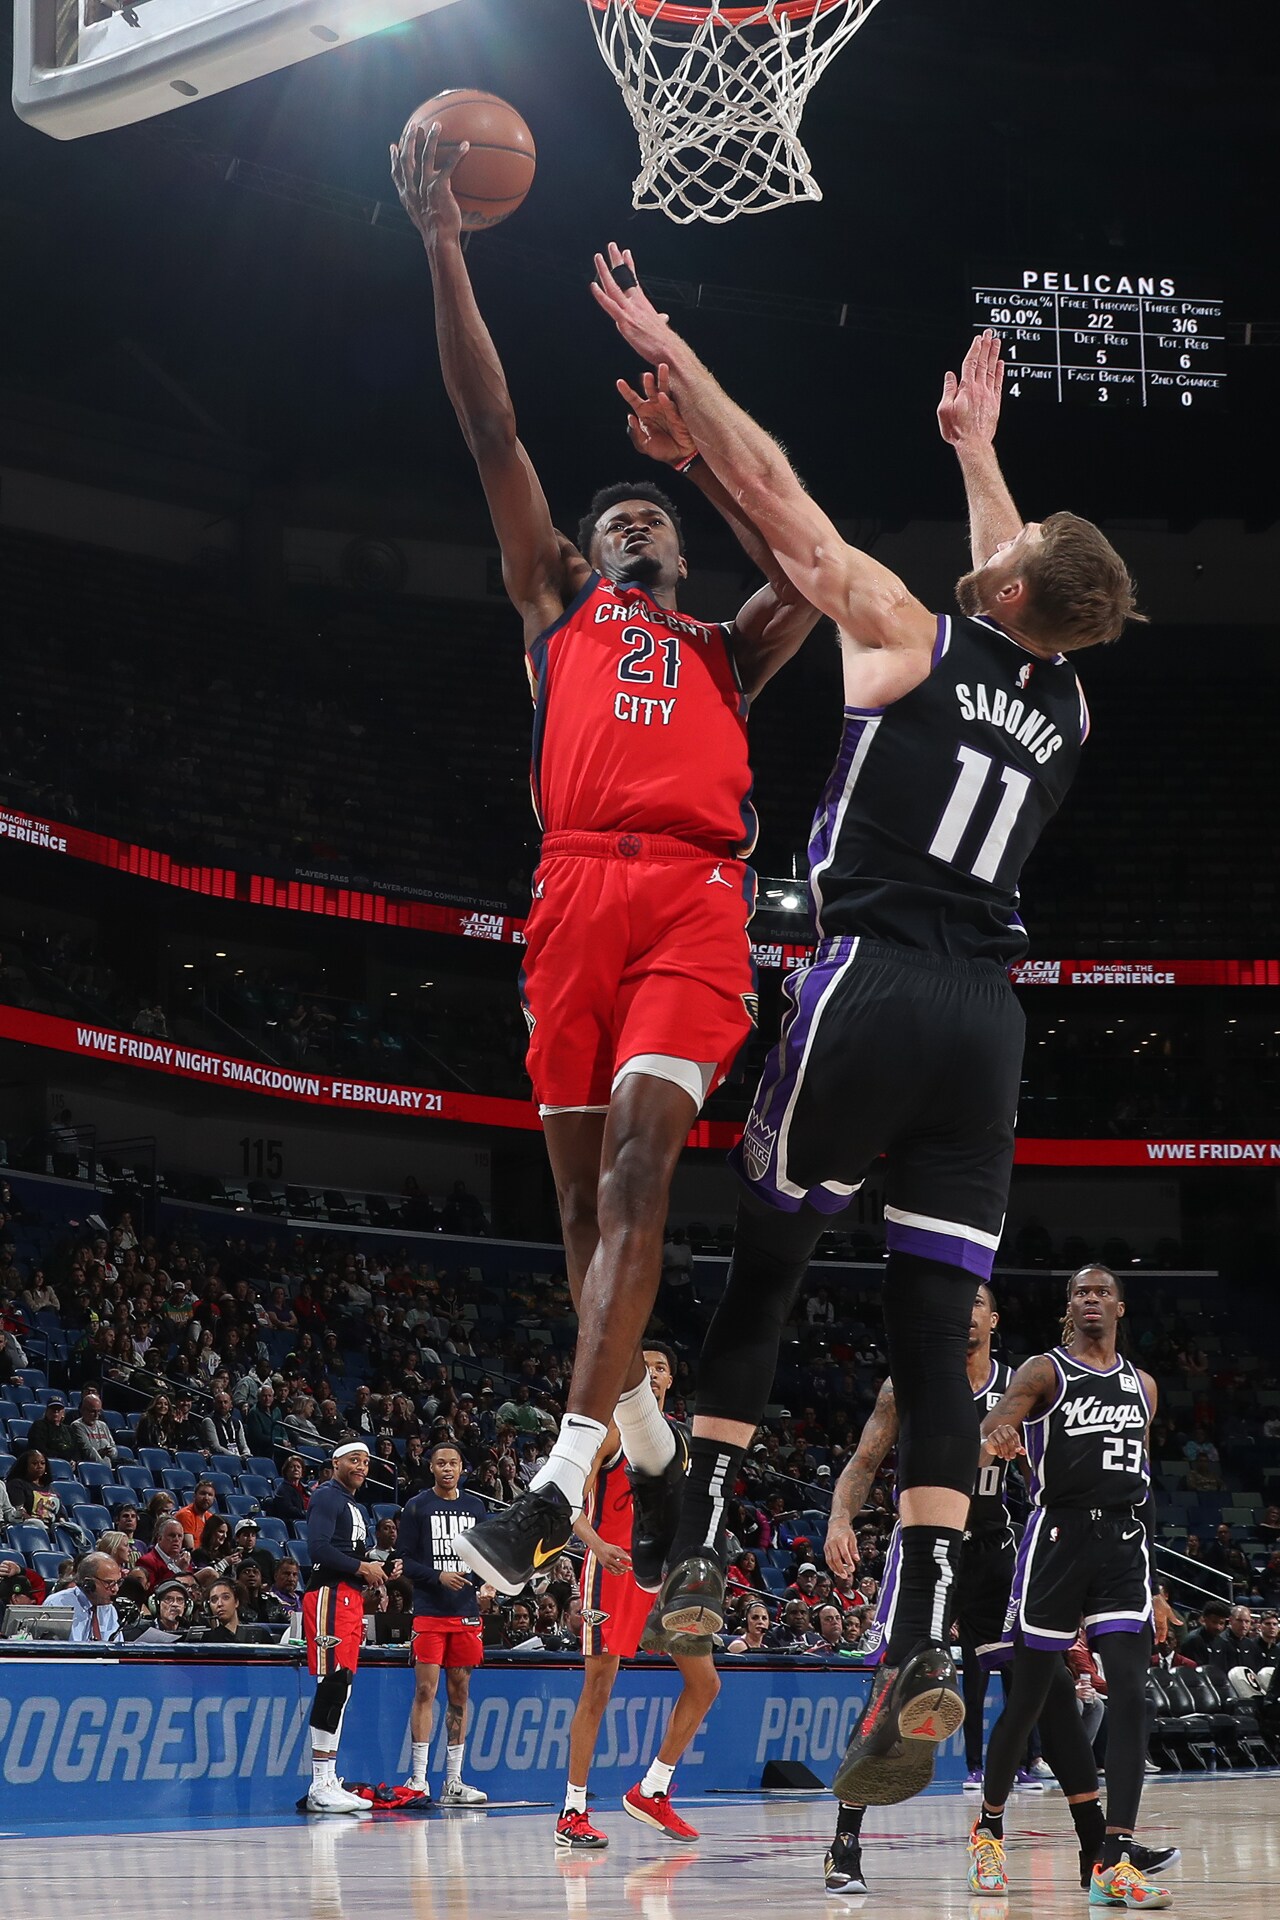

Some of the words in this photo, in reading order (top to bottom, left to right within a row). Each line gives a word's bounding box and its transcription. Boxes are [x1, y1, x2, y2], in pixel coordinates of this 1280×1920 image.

[1023, 270, 1176, 297] PELICANS
[975, 292, 1006, 305] FIELD
[1009, 294, 1053, 308] GOAL%
[1060, 296, 1089, 309] FREE
[1092, 298, 1139, 312] THROWS
[990, 308, 1042, 325] 50.0%
[1143, 301, 1178, 314] THREE
[1181, 303, 1222, 316] POINTS
[1087, 313, 1114, 329] 2/2
[1172, 318, 1198, 333] 3/6
[1016, 328, 1041, 341] REB
[1104, 333, 1129, 346] REB
[1008, 345, 1017, 359] 1
[1184, 338, 1209, 350] REB
[1096, 349, 1107, 364] 5
[1179, 354, 1191, 369] 6
[1021, 366, 1052, 379] PAINT
[1067, 369, 1095, 381] FAST
[1098, 370, 1136, 383] BREAK
[1151, 373, 1174, 385] 2ND
[1176, 374, 1220, 388] CHANCE
[1009, 382, 1022, 398] 4
[1098, 387, 1109, 402] 3
[1181, 391, 1193, 407] 0
[594, 599, 713, 645] CRESCENT
[617, 625, 682, 689] 21
[614, 691, 677, 725] CITY
[955, 683, 1063, 765] SABONIS
[928, 745, 1032, 884] 11
[0, 812, 33, 829] IMAGINE
[34, 822, 50, 834] THE
[295, 868, 329, 880] PLAYERS
[330, 874, 350, 883] PASS
[434, 891, 478, 906] COMMUNITY
[478, 899, 509, 910] TICKETS
[466, 912, 504, 934] ASM
[1019, 960, 1061, 978] ASM
[1071, 973, 1175, 984] EXPERIENCE
[77, 1027, 117, 1053] WWE
[119, 1038, 174, 1065] FRIDAY
[175, 1051, 221, 1076] NIGHT
[222, 1060, 320, 1096] SMACKDOWN
[332, 1082, 423, 1108] FEBRUARY
[425, 1093, 442, 1111] 21
[239, 1137, 283, 1179] 115
[1147, 1144, 1196, 1159] WWE
[1199, 1144, 1267, 1159] FRIDAY
[1060, 1395, 1145, 1435] Kings
[1102, 1436, 1143, 1473] 23
[972, 1465, 1000, 1496] 0
[430, 1515, 475, 1540] BLACK
[397, 1697, 707, 1774] PROGRSSIE
